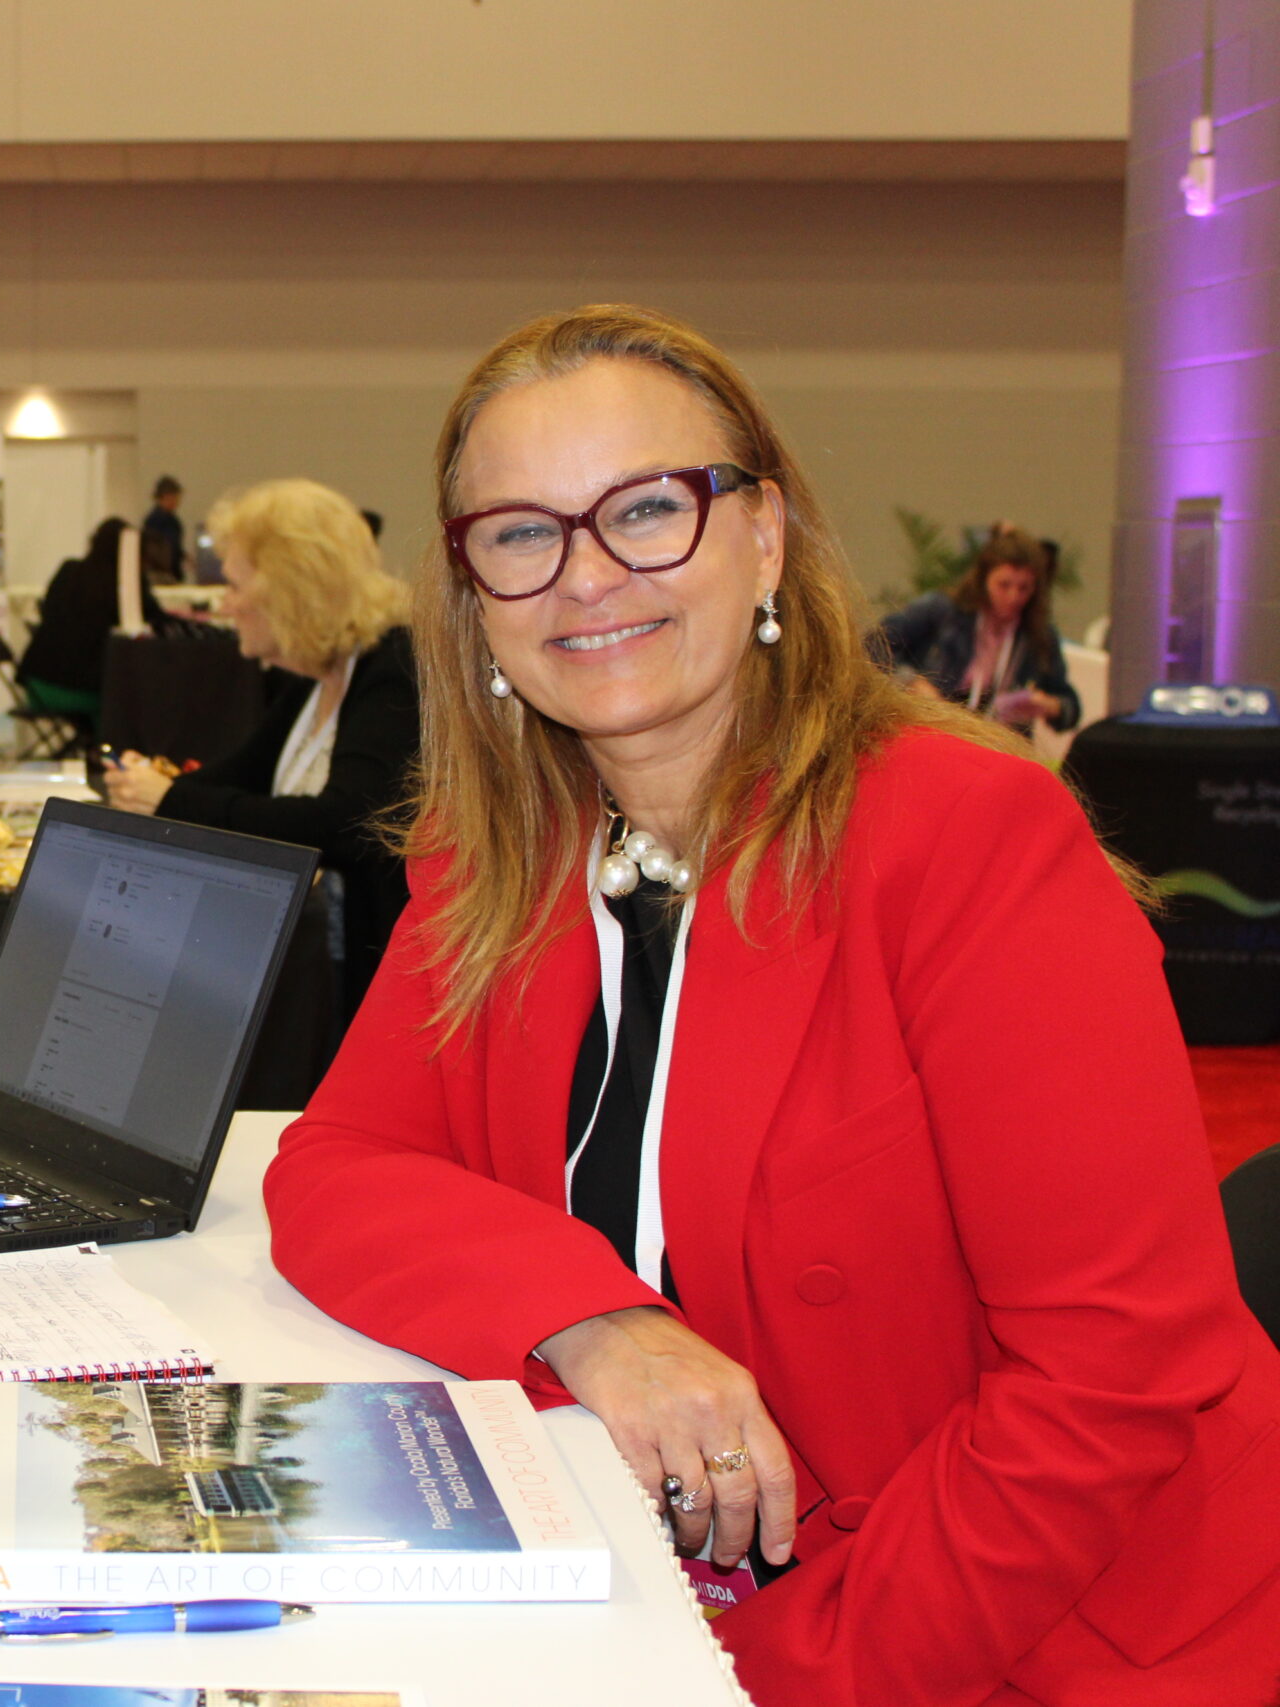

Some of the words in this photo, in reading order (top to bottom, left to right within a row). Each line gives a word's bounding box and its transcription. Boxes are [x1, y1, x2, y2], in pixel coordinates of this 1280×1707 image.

[383, 1393, 408, 1421] County
[468, 1386, 537, 1464] COMMUNITY
[435, 1447, 462, 1476] Natural
[416, 1476, 439, 1488] by
[507, 1466, 548, 1486] OF
[445, 1475, 477, 1509] Florida's
[519, 1488, 565, 1514] ART
[417, 1488, 454, 1530] Presented
[533, 1516, 577, 1542] THE
[53, 1564, 123, 1592] THE
[145, 1564, 220, 1592] ART
[243, 1565, 296, 1592] OF
[320, 1565, 587, 1592] COMMUNITY
